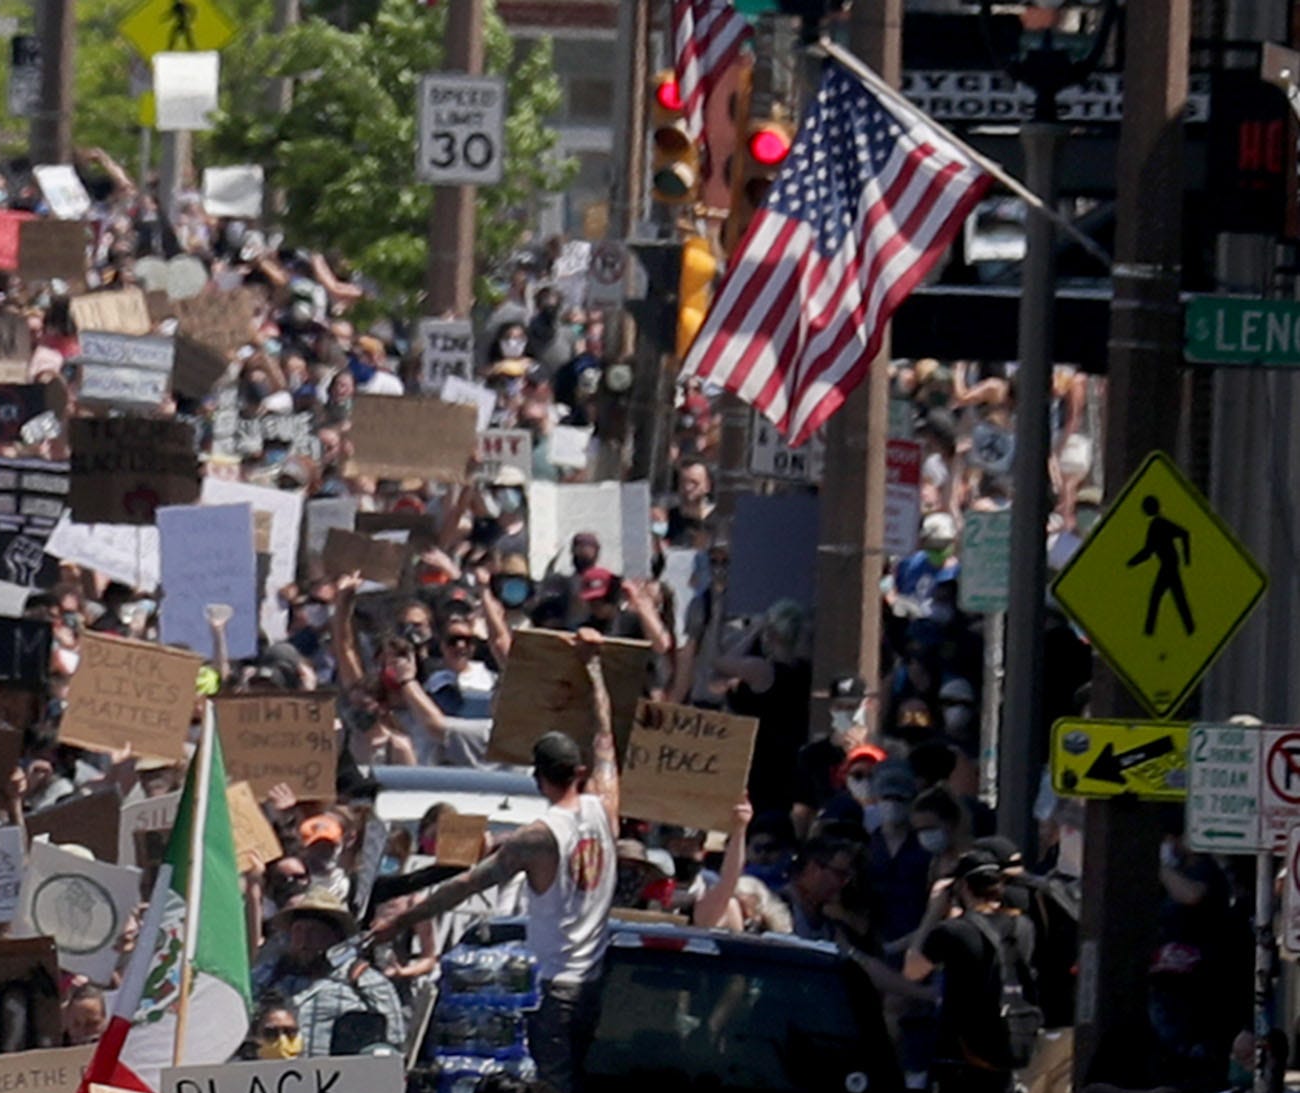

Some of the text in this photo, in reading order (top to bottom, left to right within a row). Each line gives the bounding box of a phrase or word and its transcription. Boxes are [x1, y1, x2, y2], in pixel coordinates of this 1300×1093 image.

[430, 87, 497, 105] SPEED
[435, 109, 484, 126] LIMIT
[430, 132, 494, 170] 30
[90, 649, 166, 681] BLACK
[95, 675, 181, 705] LIVES
[76, 698, 174, 726] MATTER
[659, 744, 720, 777] PEACE
